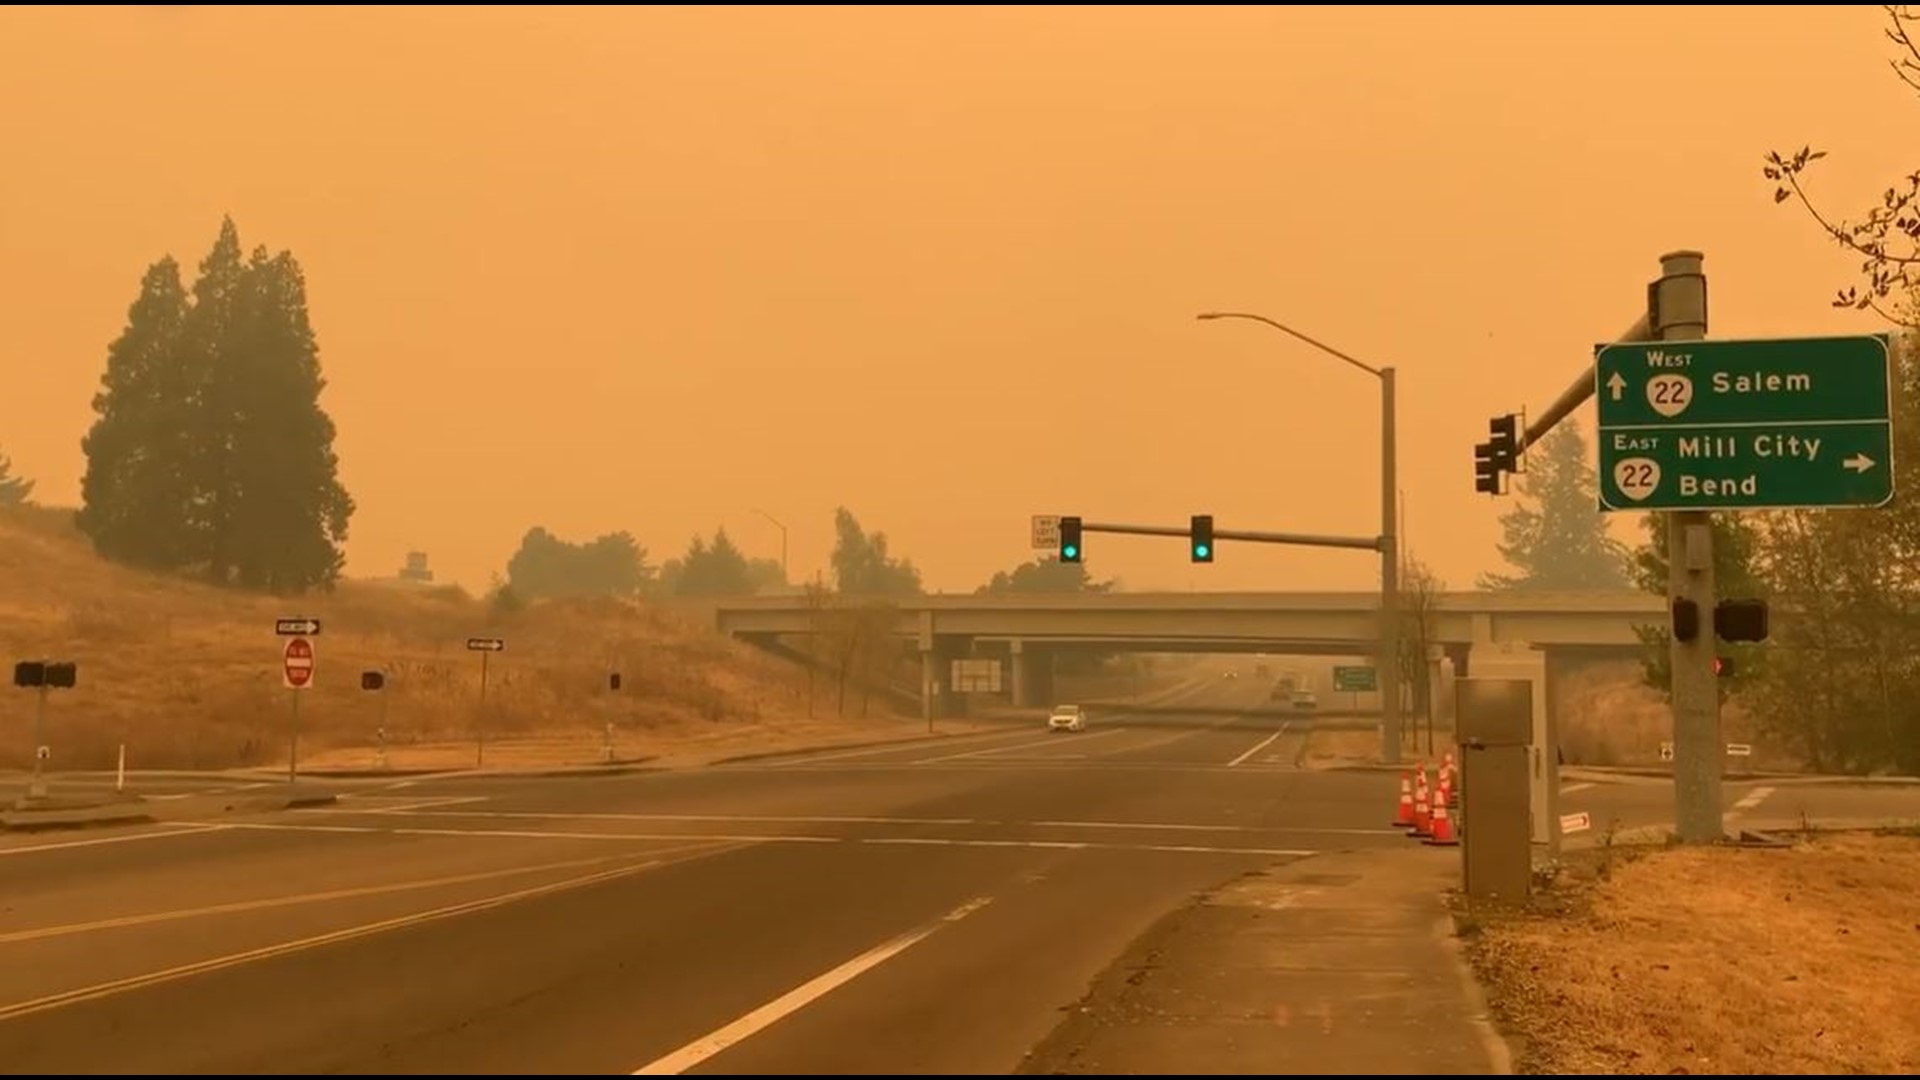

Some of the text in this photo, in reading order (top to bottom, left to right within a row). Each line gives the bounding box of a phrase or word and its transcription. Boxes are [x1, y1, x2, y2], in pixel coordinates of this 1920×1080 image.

[1654, 371, 1810, 404] 22 Salem
[1679, 435, 1820, 460] Mill City
[1622, 464, 1652, 487] 22
[1680, 475, 1756, 496] Bend
